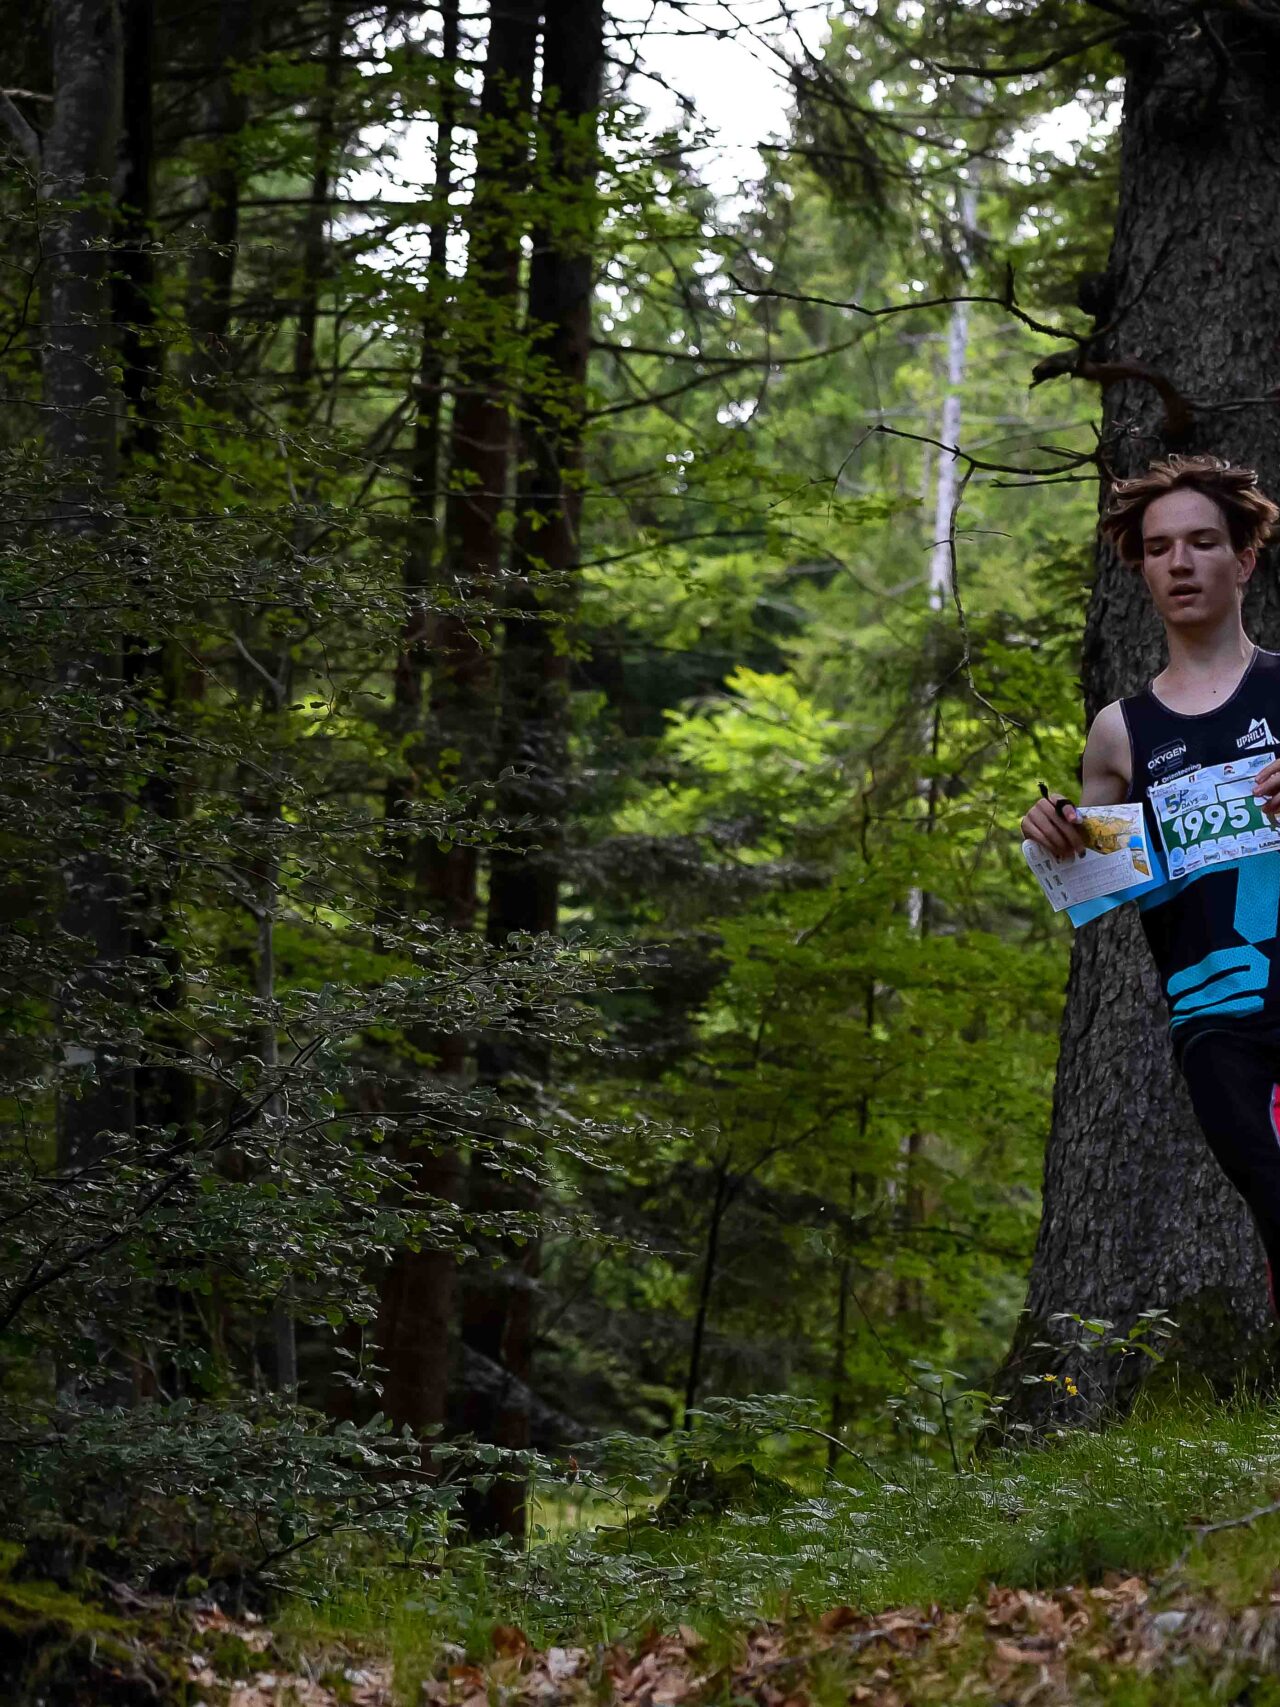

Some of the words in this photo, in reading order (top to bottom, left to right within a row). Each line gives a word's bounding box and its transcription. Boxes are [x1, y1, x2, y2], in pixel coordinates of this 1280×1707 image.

[1236, 726, 1265, 748] UPHILL
[1147, 745, 1187, 769] OXYGEN
[1162, 763, 1201, 783] Orienteering
